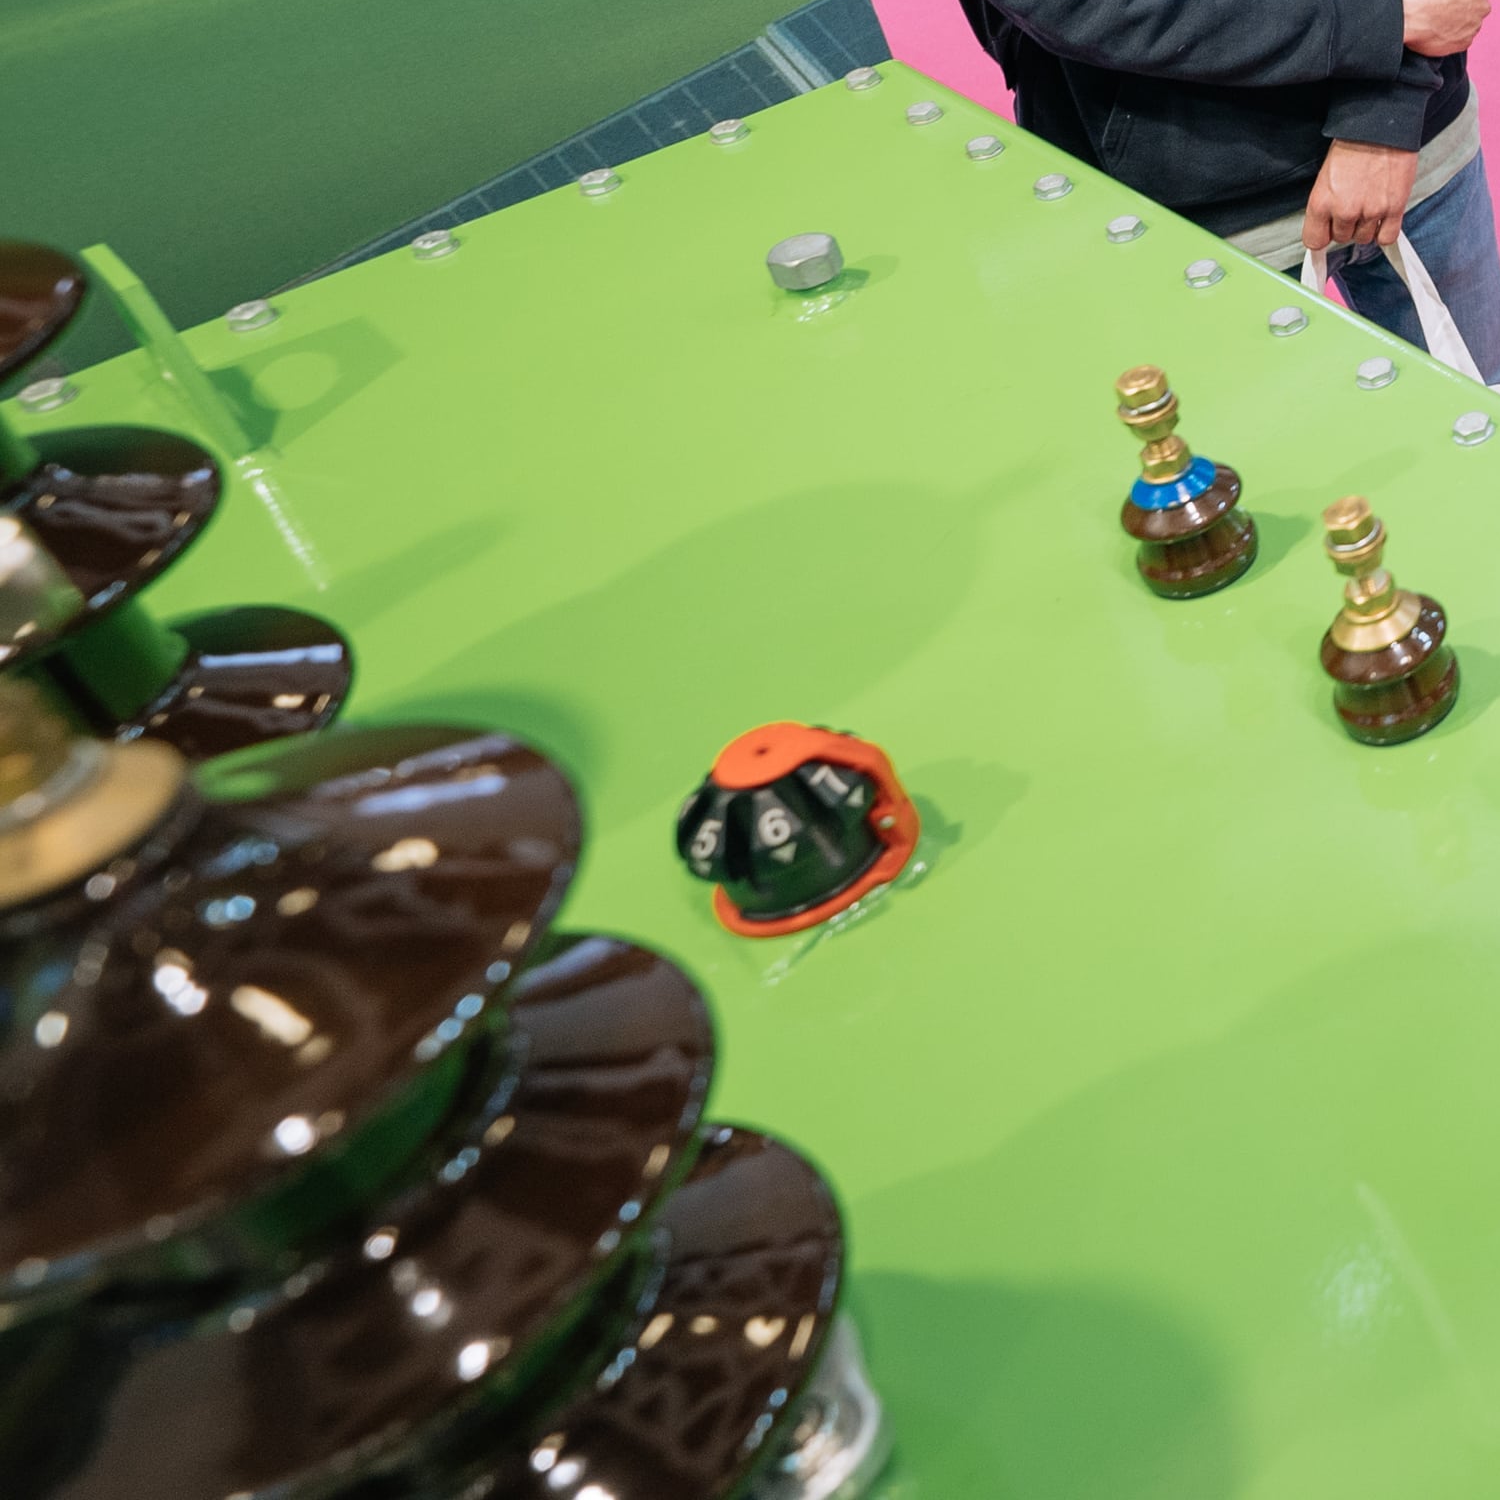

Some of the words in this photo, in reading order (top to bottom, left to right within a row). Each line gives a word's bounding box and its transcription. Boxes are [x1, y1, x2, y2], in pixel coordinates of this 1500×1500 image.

[809, 764, 850, 795] 7
[690, 818, 723, 861] 5
[758, 807, 792, 846] 6
